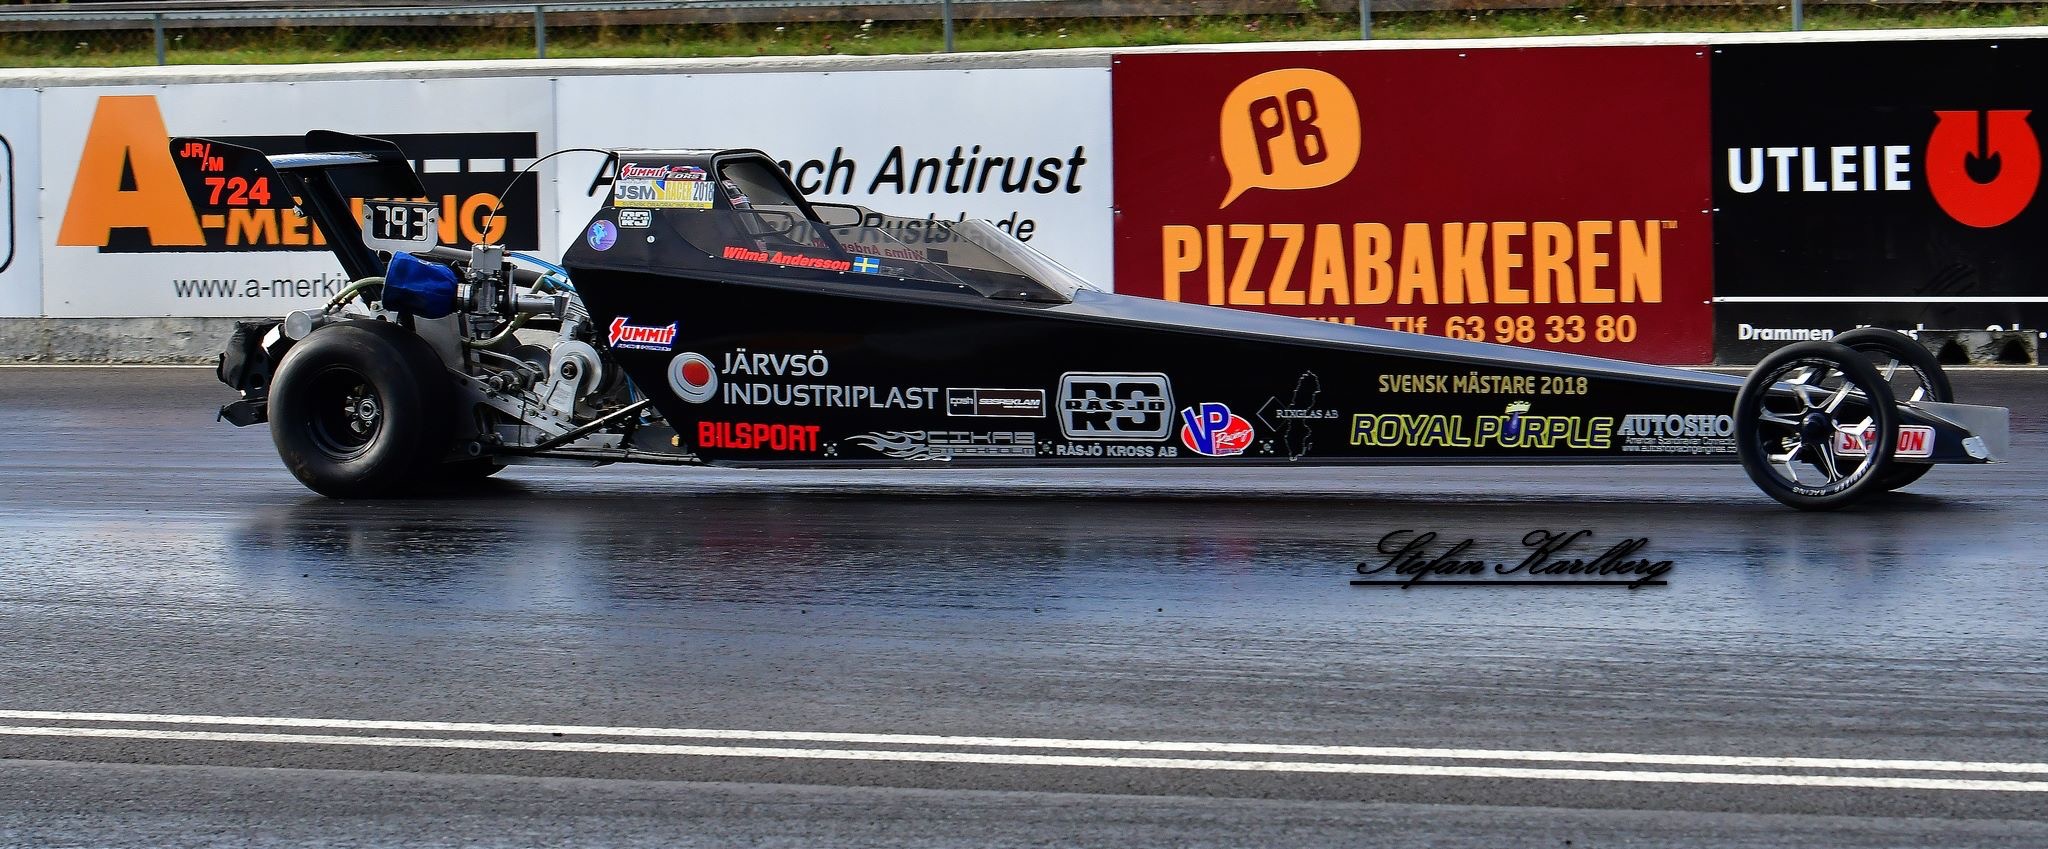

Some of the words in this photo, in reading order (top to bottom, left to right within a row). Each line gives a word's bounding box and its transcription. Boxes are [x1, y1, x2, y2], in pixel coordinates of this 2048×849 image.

[1249, 87, 1328, 175] PB
[868, 144, 1086, 195] Antirust
[1727, 145, 1911, 193] UTLEIE
[204, 177, 271, 206] 724
[614, 185, 656, 200] JSM
[722, 246, 769, 263] Wilma
[770, 251, 851, 272] Andersson
[1162, 219, 1662, 306] PIZZABAKEREN
[1445, 315, 1486, 343] 63
[1494, 315, 1536, 343] 98
[1545, 315, 1586, 343] 33
[1595, 315, 1637, 343] 80
[722, 348, 828, 376] JÄRVSÖ
[723, 382, 939, 410] INDUSTRIPLAST
[1378, 374, 1448, 393] SVENSK
[1453, 372, 1535, 394] MÄSTARE
[1540, 376, 1588, 395] 2018
[699, 421, 819, 452] BILSPORT
[1350, 413, 1472, 446] ROYAL
[1475, 414, 1614, 449] PURPLE
[1616, 414, 1735, 437] AUTOSHO
[1056, 442, 1103, 456] RÅSJÖ
[1106, 445, 1154, 457] KROSS
[1157, 446, 1178, 457] AB
